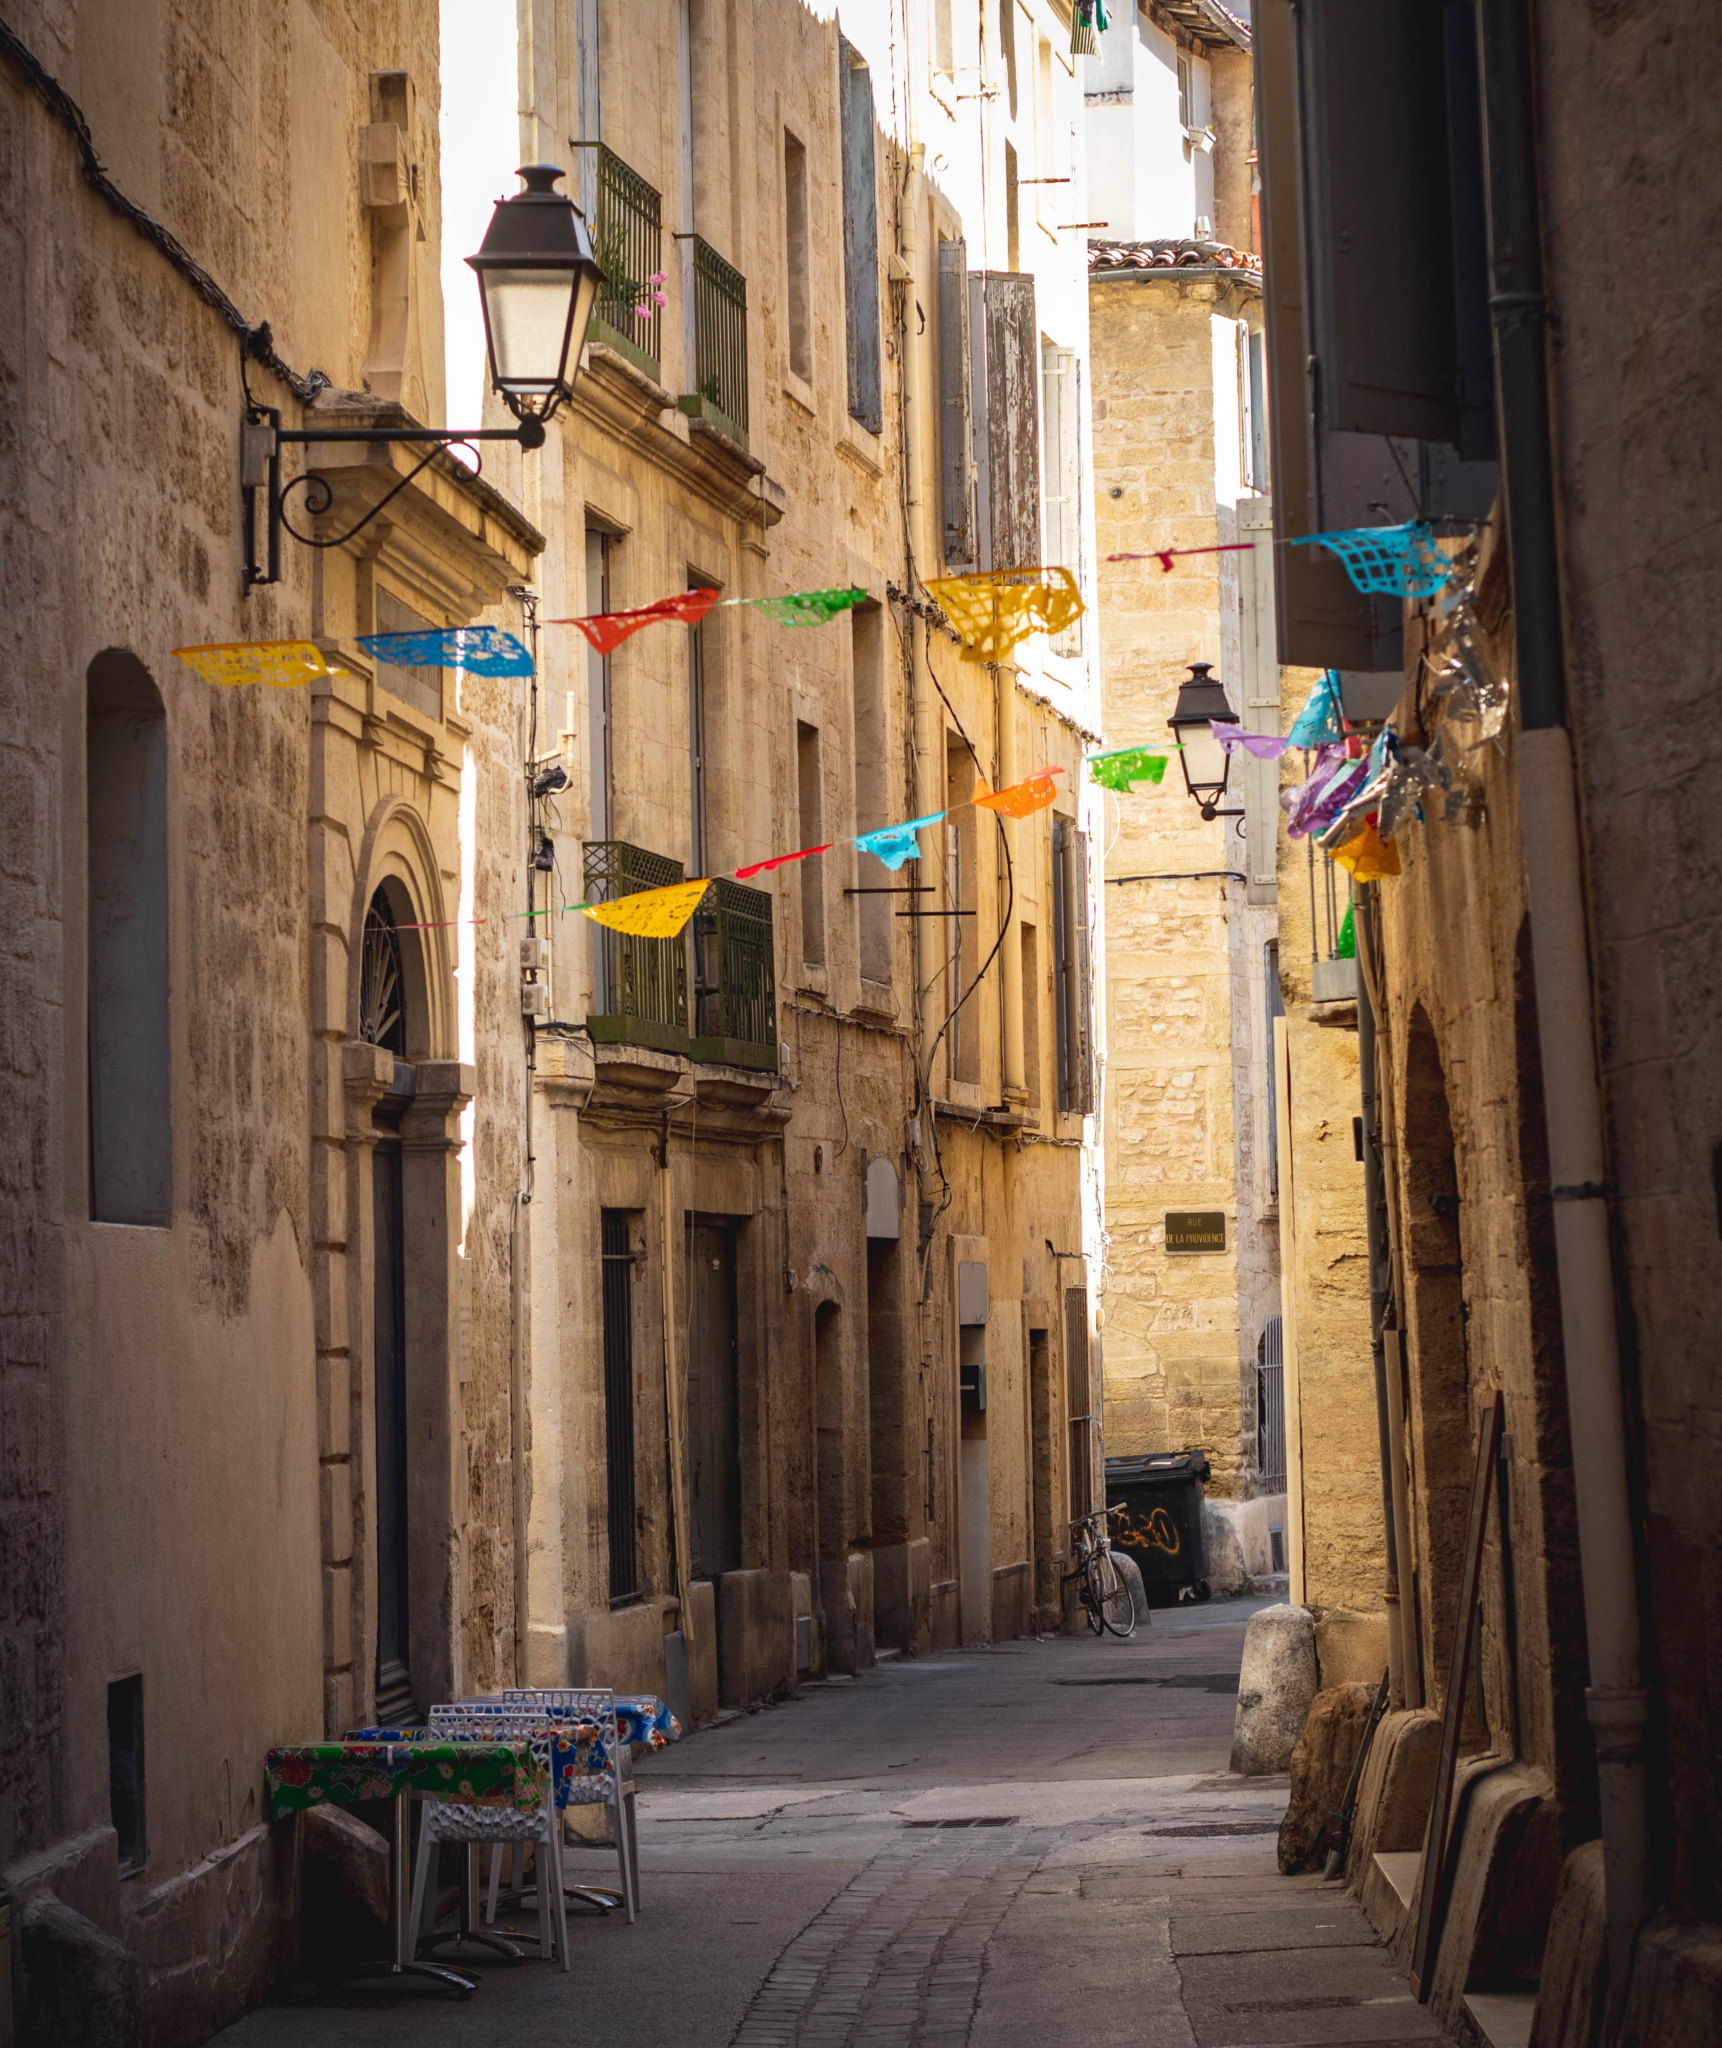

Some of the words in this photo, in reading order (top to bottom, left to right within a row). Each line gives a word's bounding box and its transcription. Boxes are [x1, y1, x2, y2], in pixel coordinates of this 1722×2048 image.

[1188, 1218, 1202, 1226] RUE
[1166, 1234, 1174, 1243] DE
[1176, 1234, 1184, 1243] LA
[1186, 1233, 1224, 1243] PROVIDENCE
